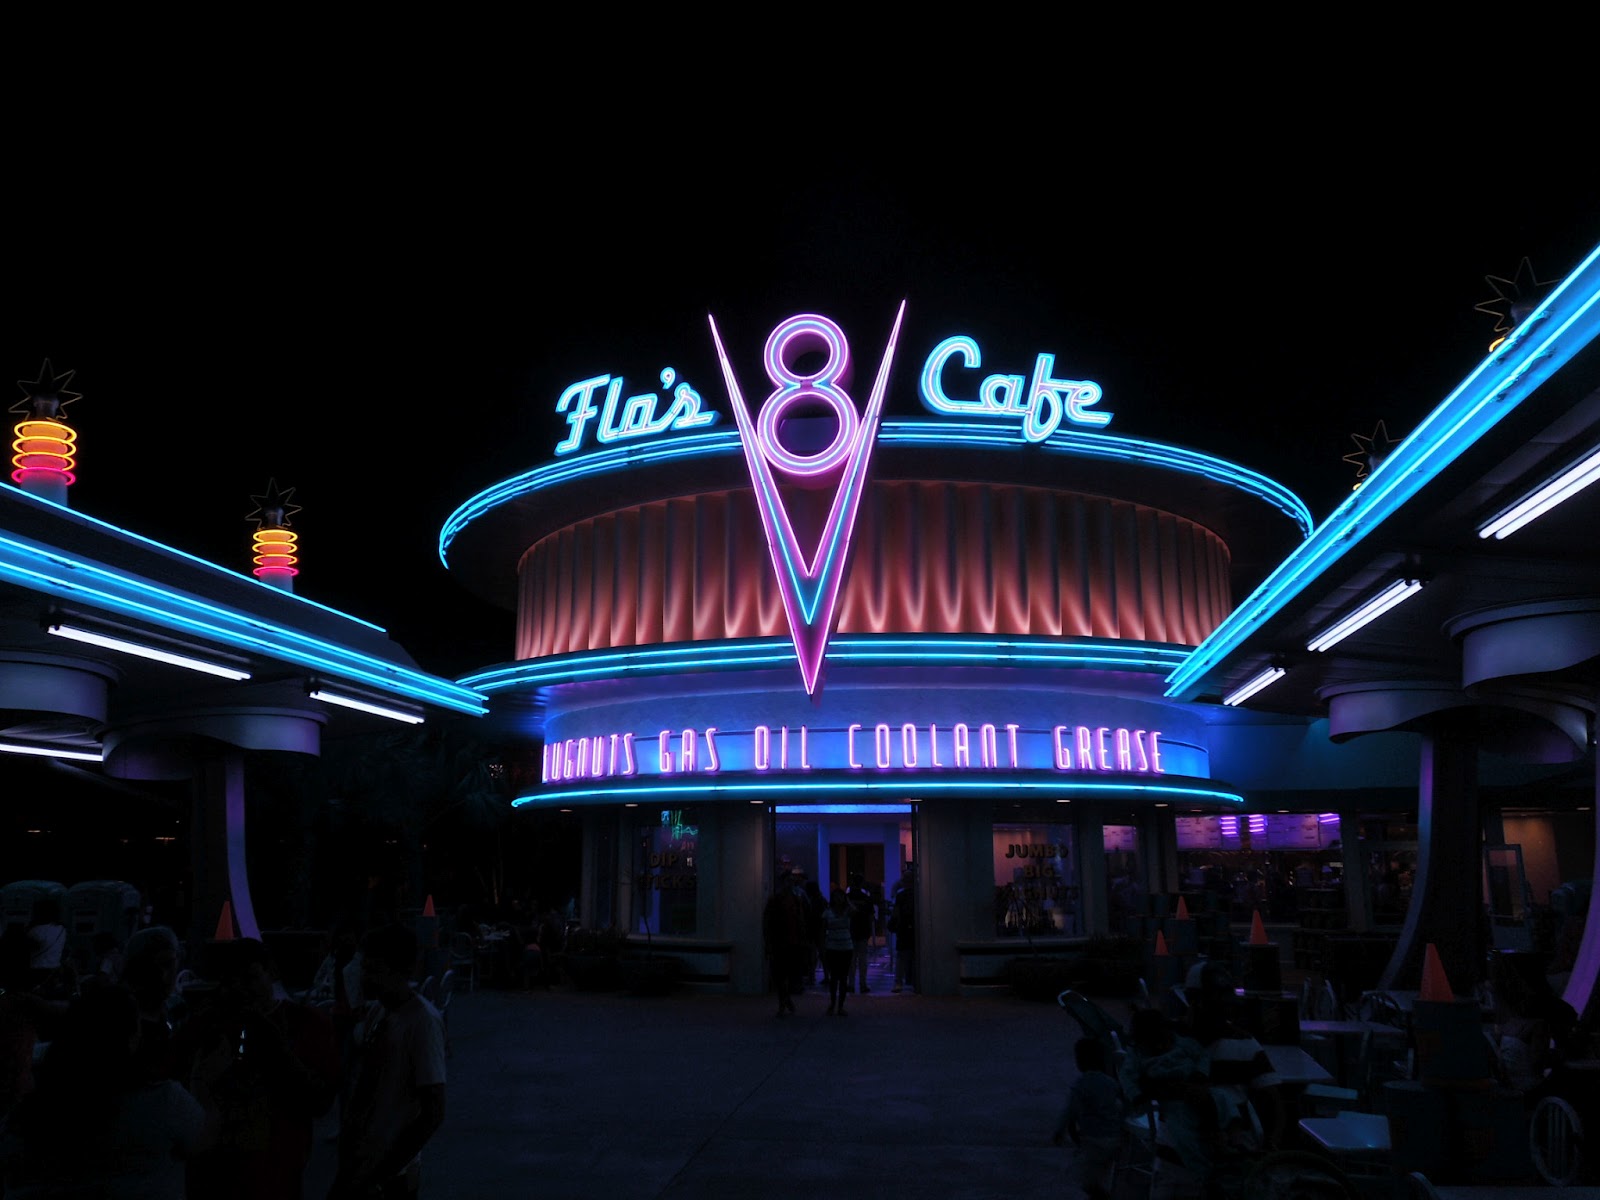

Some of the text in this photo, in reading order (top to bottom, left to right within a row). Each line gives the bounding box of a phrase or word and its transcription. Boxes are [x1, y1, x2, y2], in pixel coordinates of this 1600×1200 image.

[554, 367, 720, 456] Flo's
[918, 336, 1114, 444] Cafe
[542, 723, 1165, 783] LUGNUTS GAS OIL COOLANT GREASE
[1005, 844, 1069, 858] JUMBO
[649, 852, 678, 868] DIP
[1023, 864, 1055, 879] BIG
